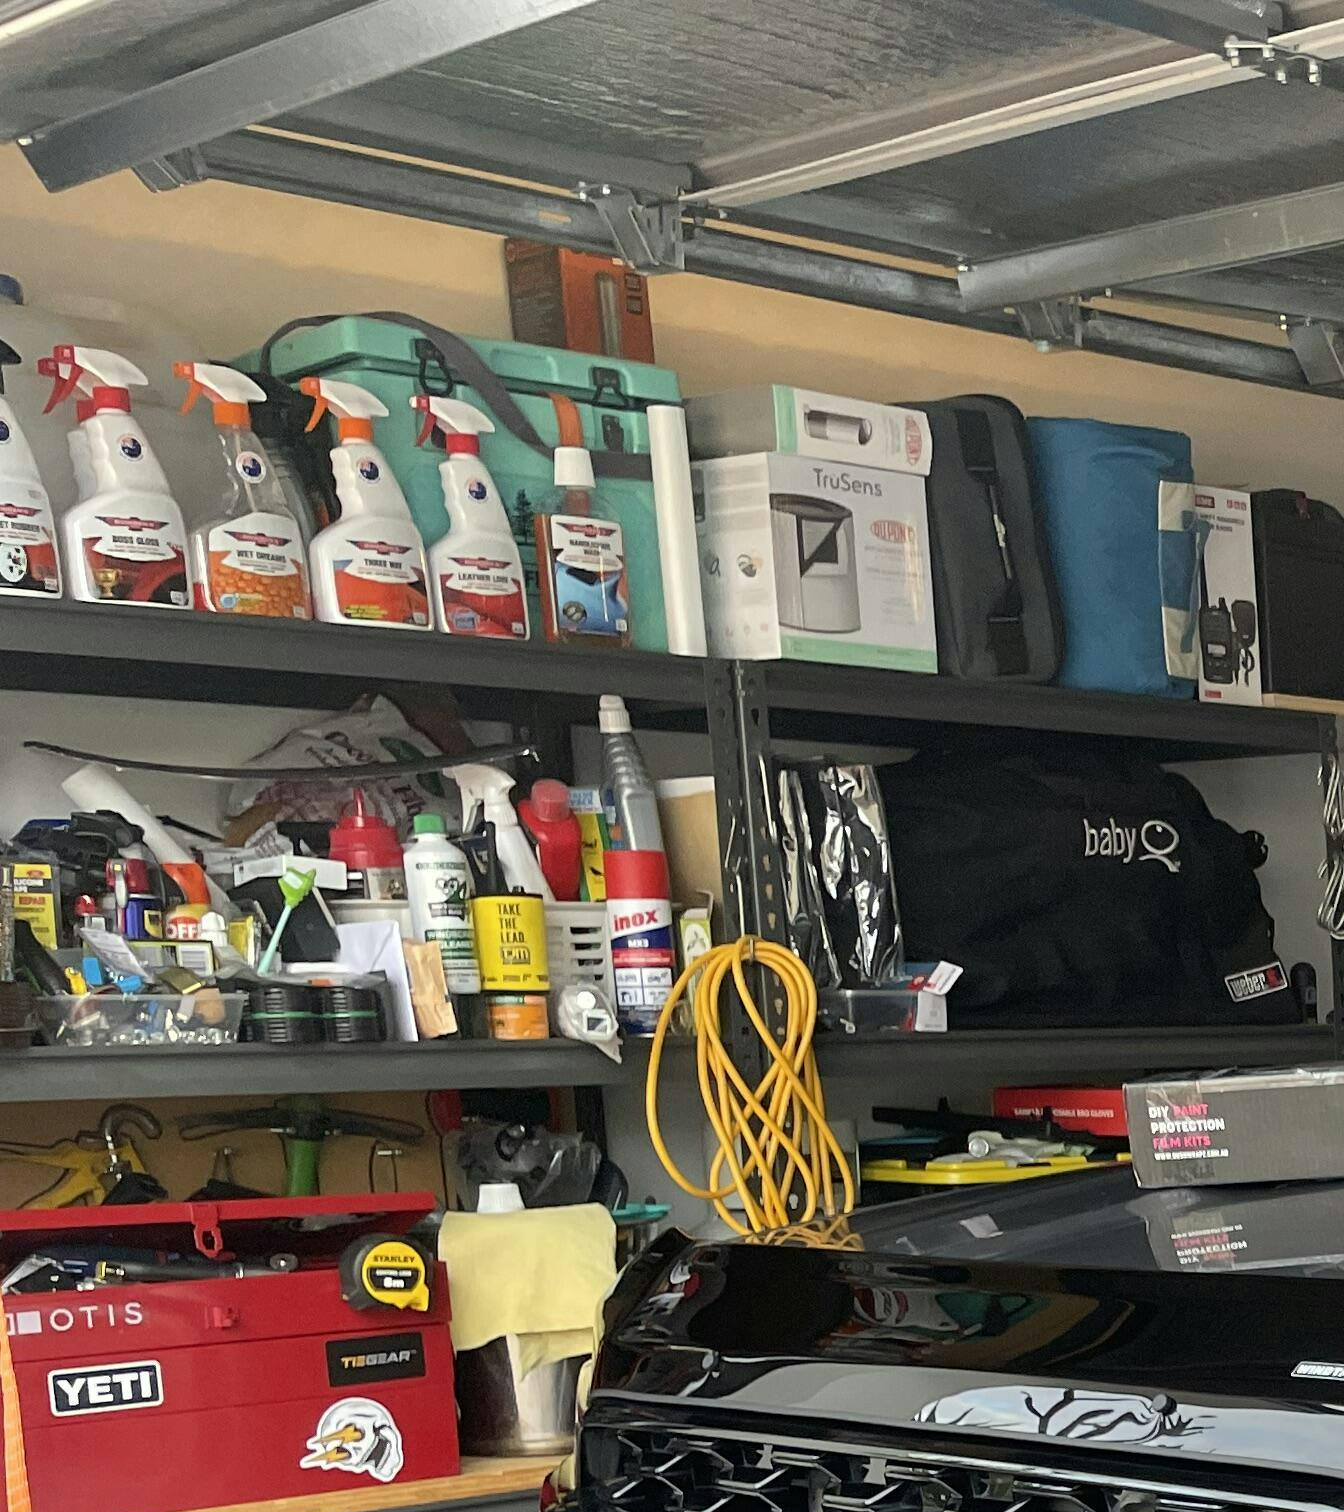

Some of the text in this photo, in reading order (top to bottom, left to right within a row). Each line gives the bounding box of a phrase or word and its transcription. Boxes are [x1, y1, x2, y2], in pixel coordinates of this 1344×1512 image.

[813, 468, 883, 497] TruSens
[458, 573, 491, 582] LEATHER
[498, 903, 521, 916] TAKE
[499, 917, 517, 929] THE
[614, 909, 658, 932] inox
[1229, 972, 1266, 997] weber
[1148, 1103, 1209, 1119] DIY PAINT
[1150, 1118, 1226, 1134] PROTECTION
[1153, 1135, 1212, 1149] FILM KITS
[373, 1255, 415, 1263] STANLEY
[50, 1302, 143, 1332] OTIS
[56, 1370, 153, 1407] YETI
